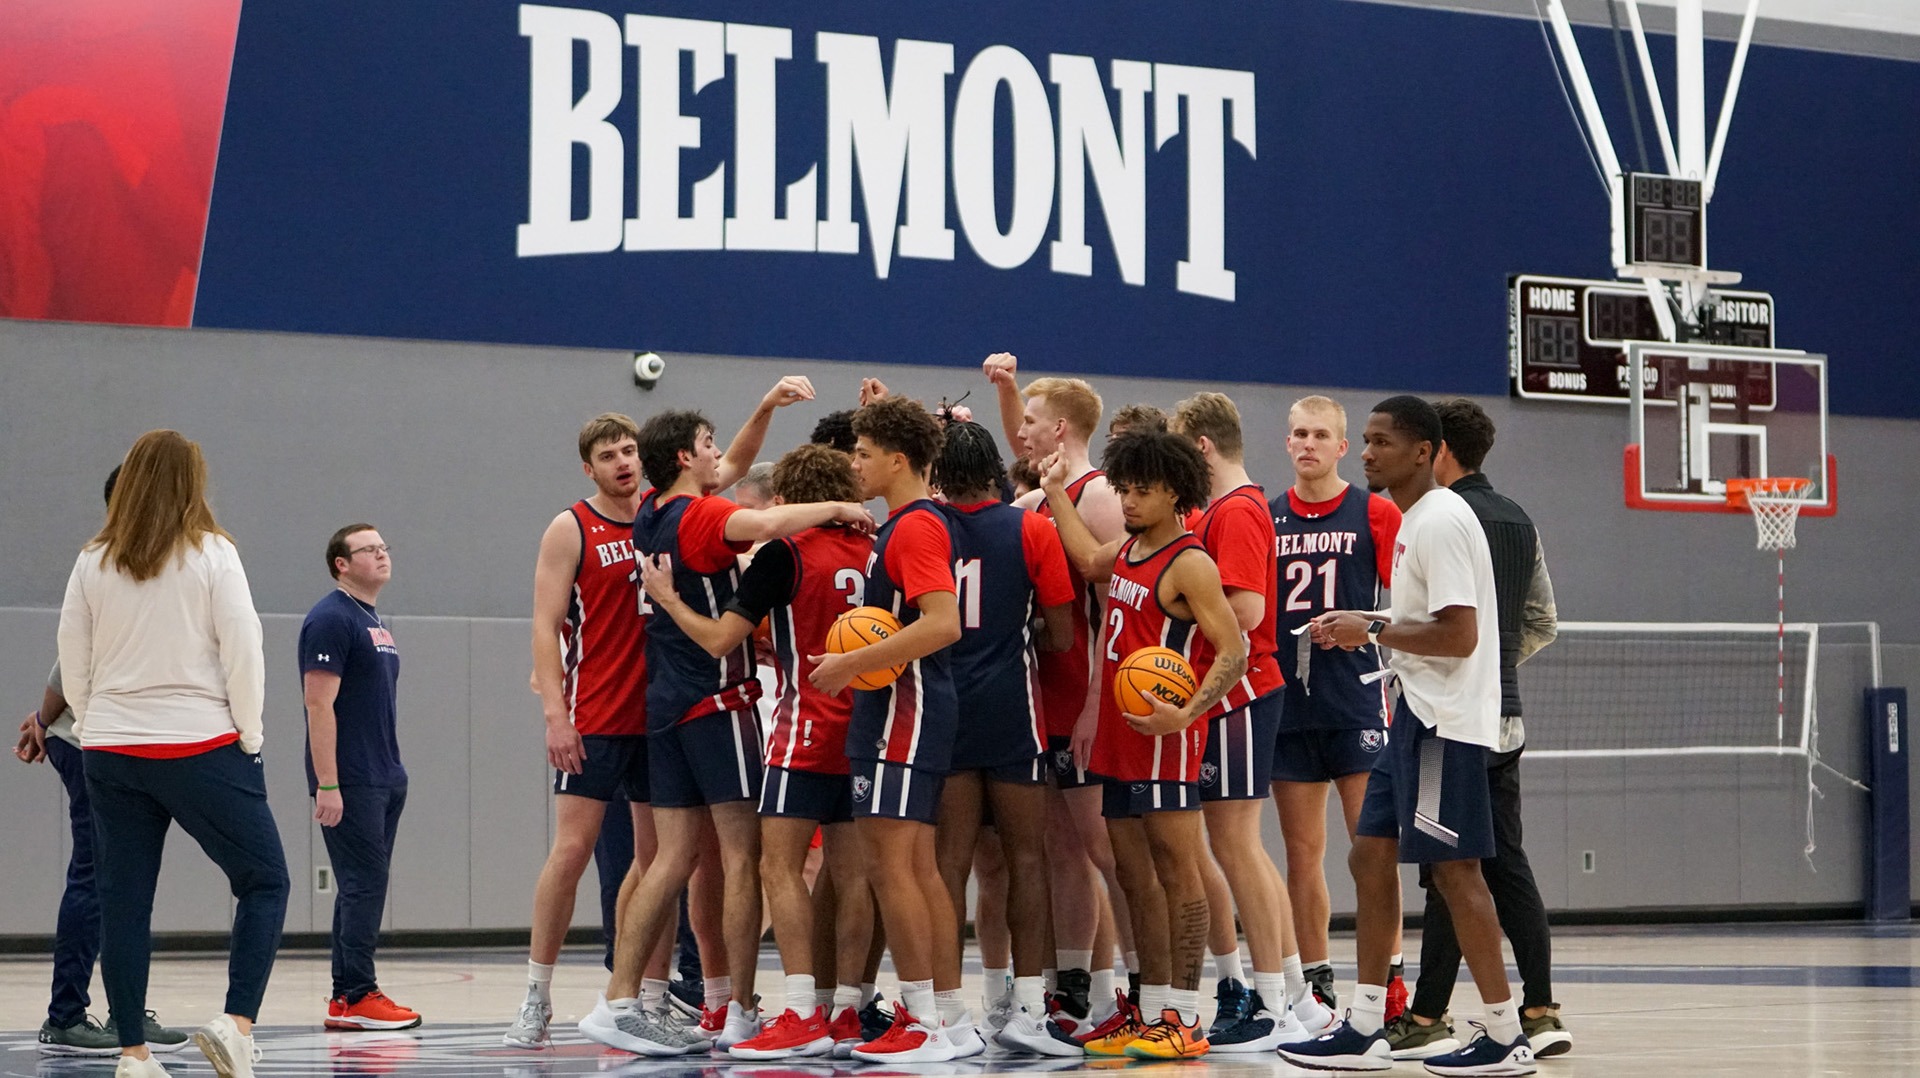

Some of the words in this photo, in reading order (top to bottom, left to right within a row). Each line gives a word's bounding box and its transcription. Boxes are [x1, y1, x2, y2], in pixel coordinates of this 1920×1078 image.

[517, 4, 1257, 302] BELMONT
[1528, 287, 1576, 311] HOME
[1715, 300, 1769, 325] ISITOR
[1548, 371, 1588, 390] BONUS
[1617, 365, 1659, 383] PEOD
[1711, 384, 1737, 399] BON
[1109, 573, 1150, 612] ELMONT
[1285, 557, 1337, 613] 21
[1106, 607, 1125, 662] 2
[1154, 656, 1196, 692] Wilson
[1150, 682, 1187, 710] NCAA
